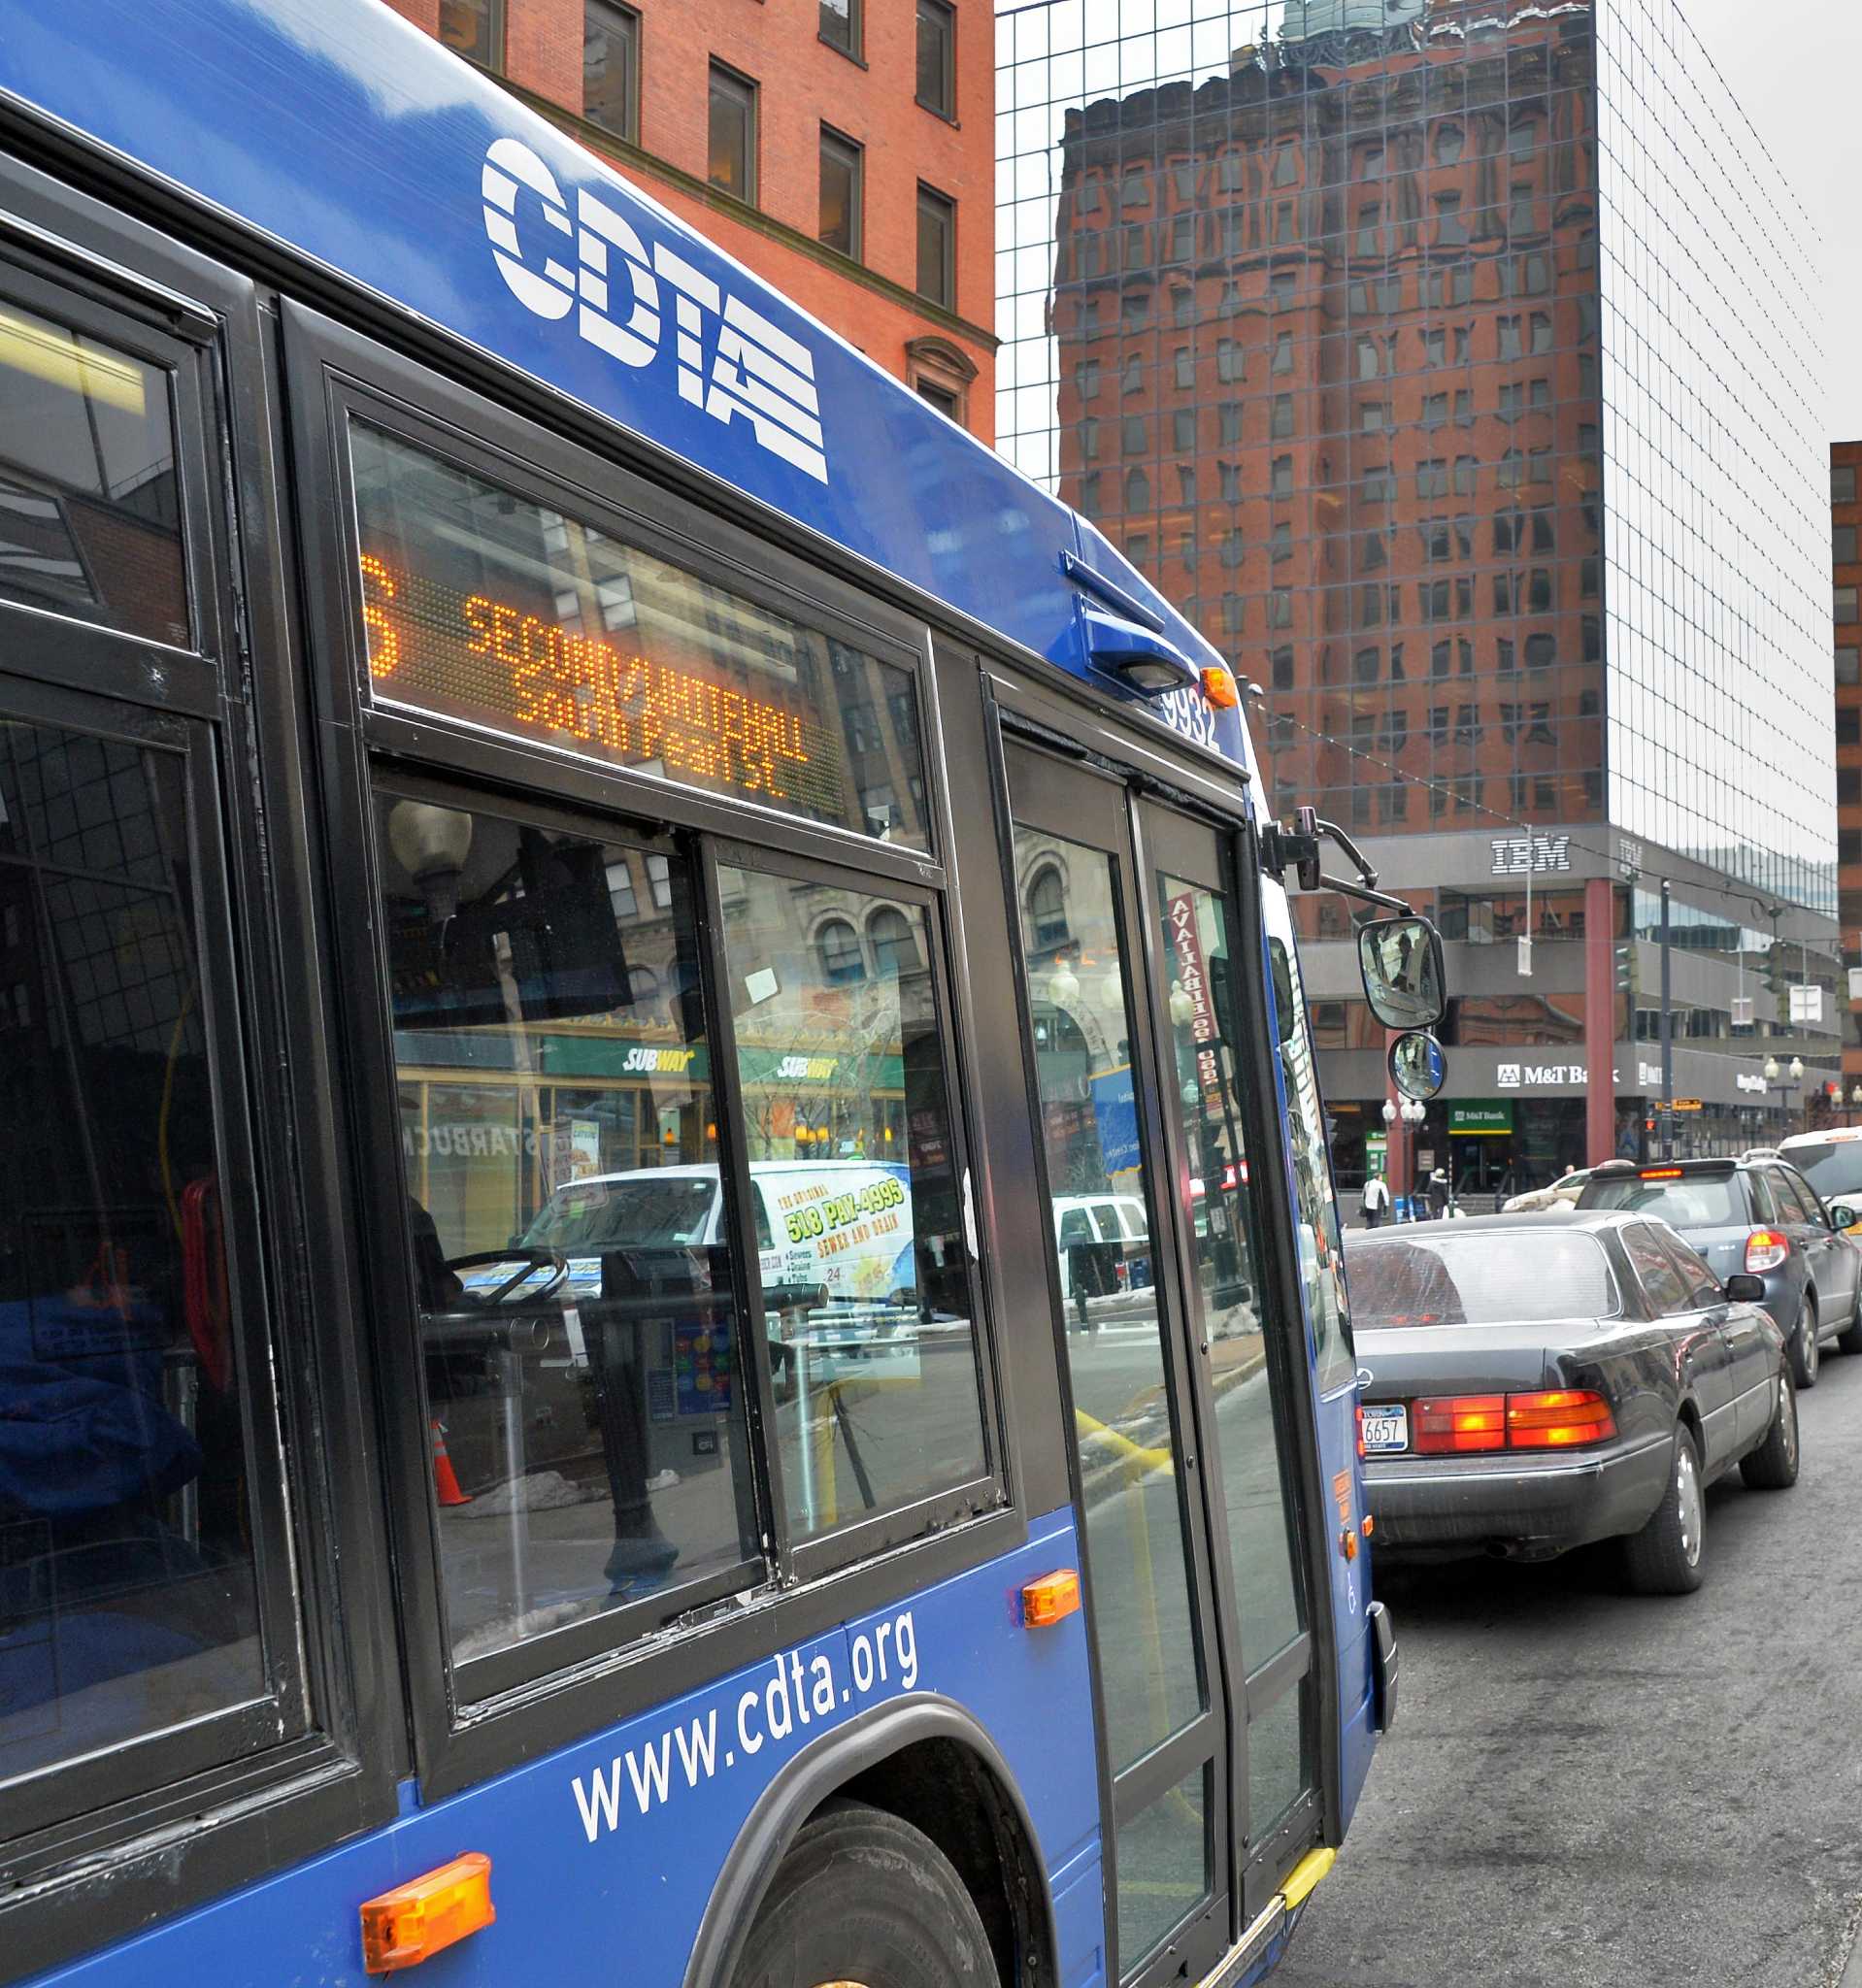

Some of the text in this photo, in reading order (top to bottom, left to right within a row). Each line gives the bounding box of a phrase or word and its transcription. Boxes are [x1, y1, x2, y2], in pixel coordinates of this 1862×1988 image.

[482, 138, 829, 485] CDTA
[513, 667, 628, 751] South
[742, 744, 785, 798] St
[1491, 837, 1570, 874] IBM
[622, 1048, 695, 1072] SUBWAY
[777, 1056, 839, 1078] SUBWAY
[1524, 1066, 1567, 1084] M&T
[1466, 1110, 1505, 1120] M&T Bank
[784, 1207, 823, 1243] 518
[851, 1224, 871, 1245] AND
[1365, 1418, 1398, 1442] 6657
[571, 1611, 917, 1843] www.cdta.org
